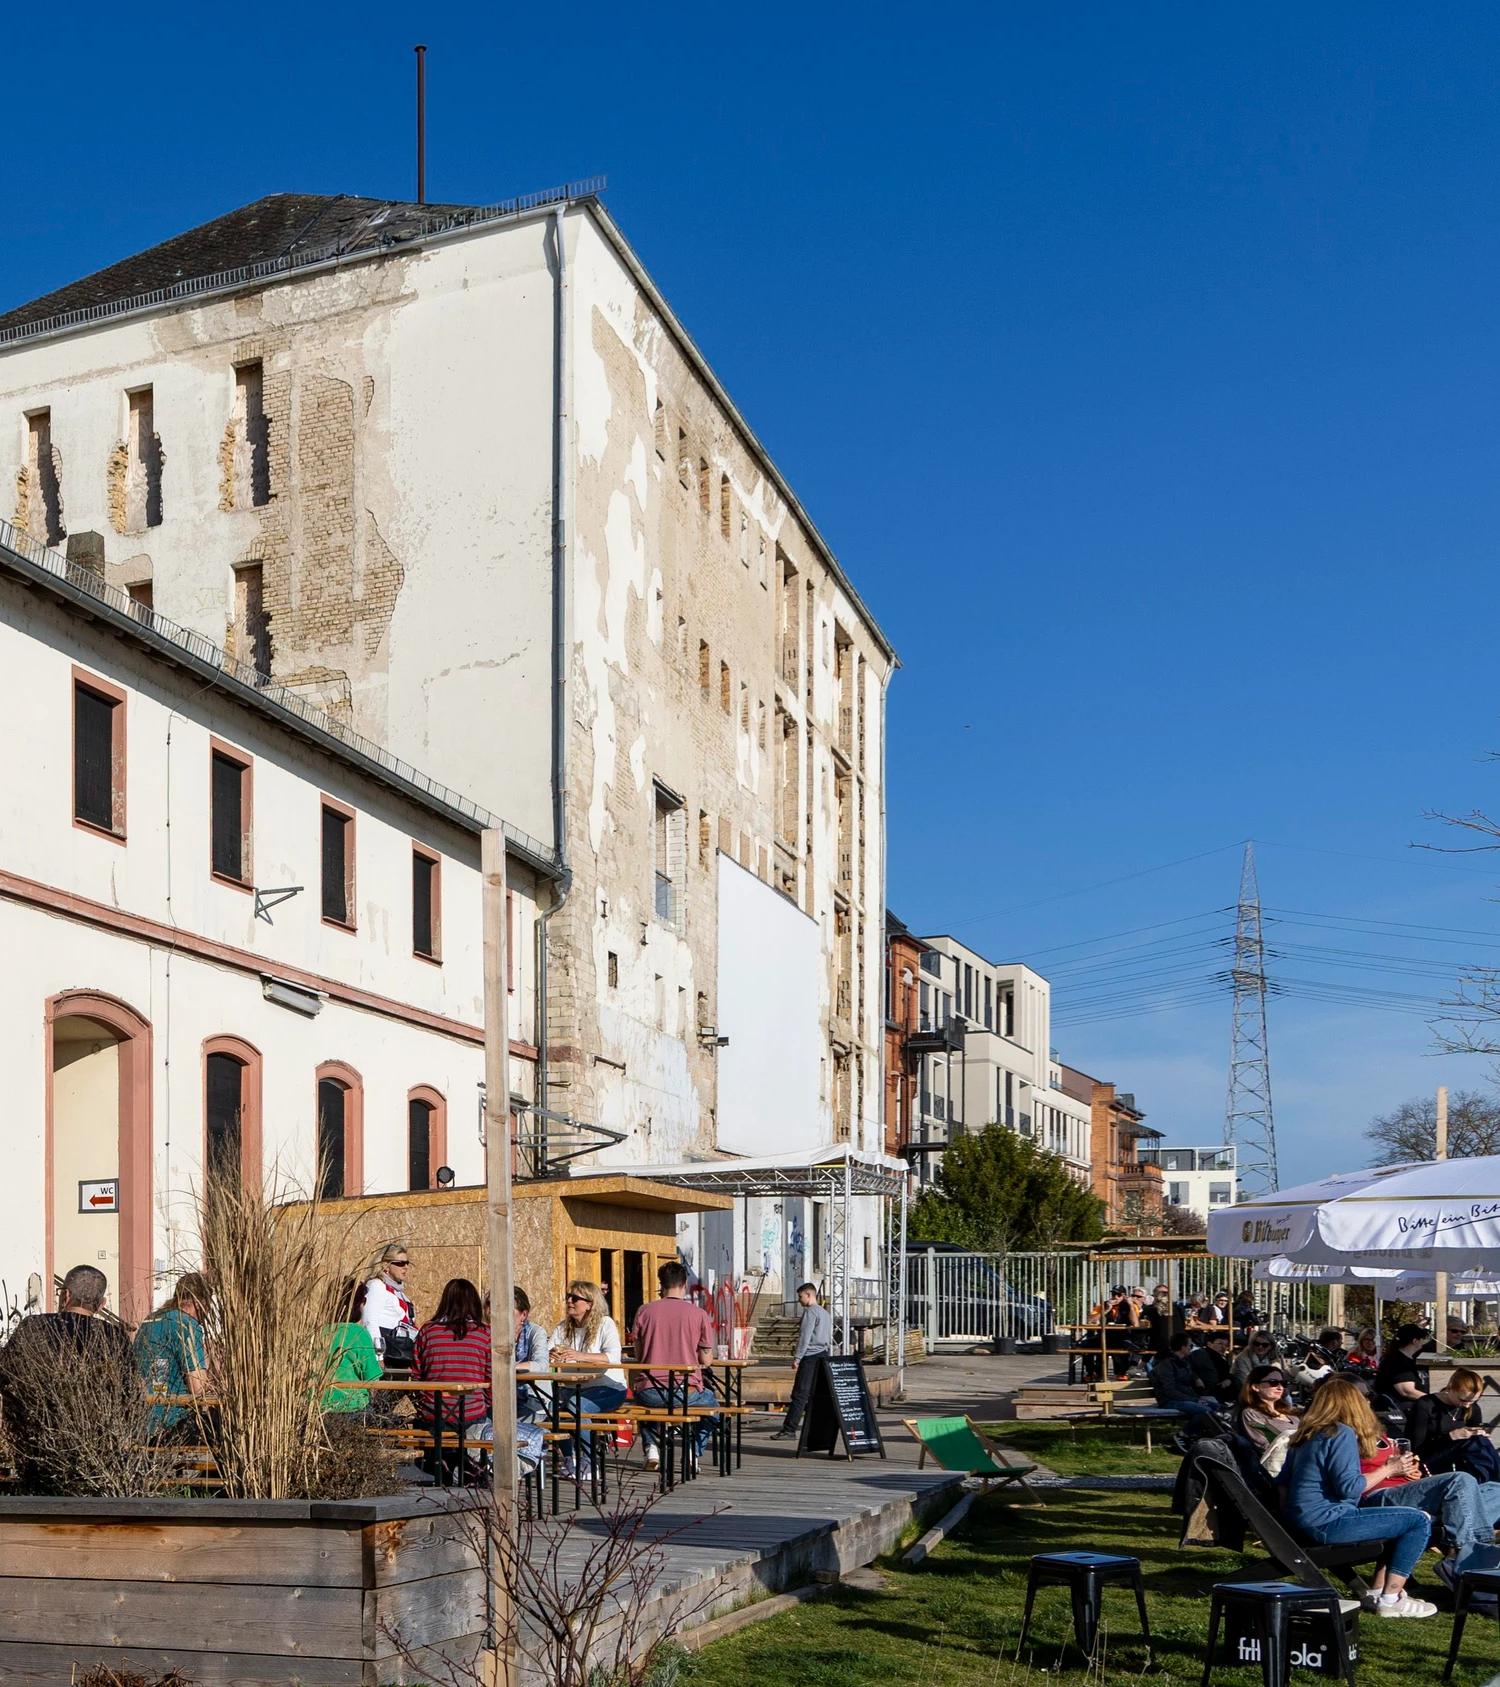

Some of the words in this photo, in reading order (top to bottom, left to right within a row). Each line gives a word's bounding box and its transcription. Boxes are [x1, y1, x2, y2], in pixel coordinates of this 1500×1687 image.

[100, 1187, 114, 1195] WC
[1398, 1217, 1435, 1233] Bitte
[1442, 1214, 1466, 1224] ein
